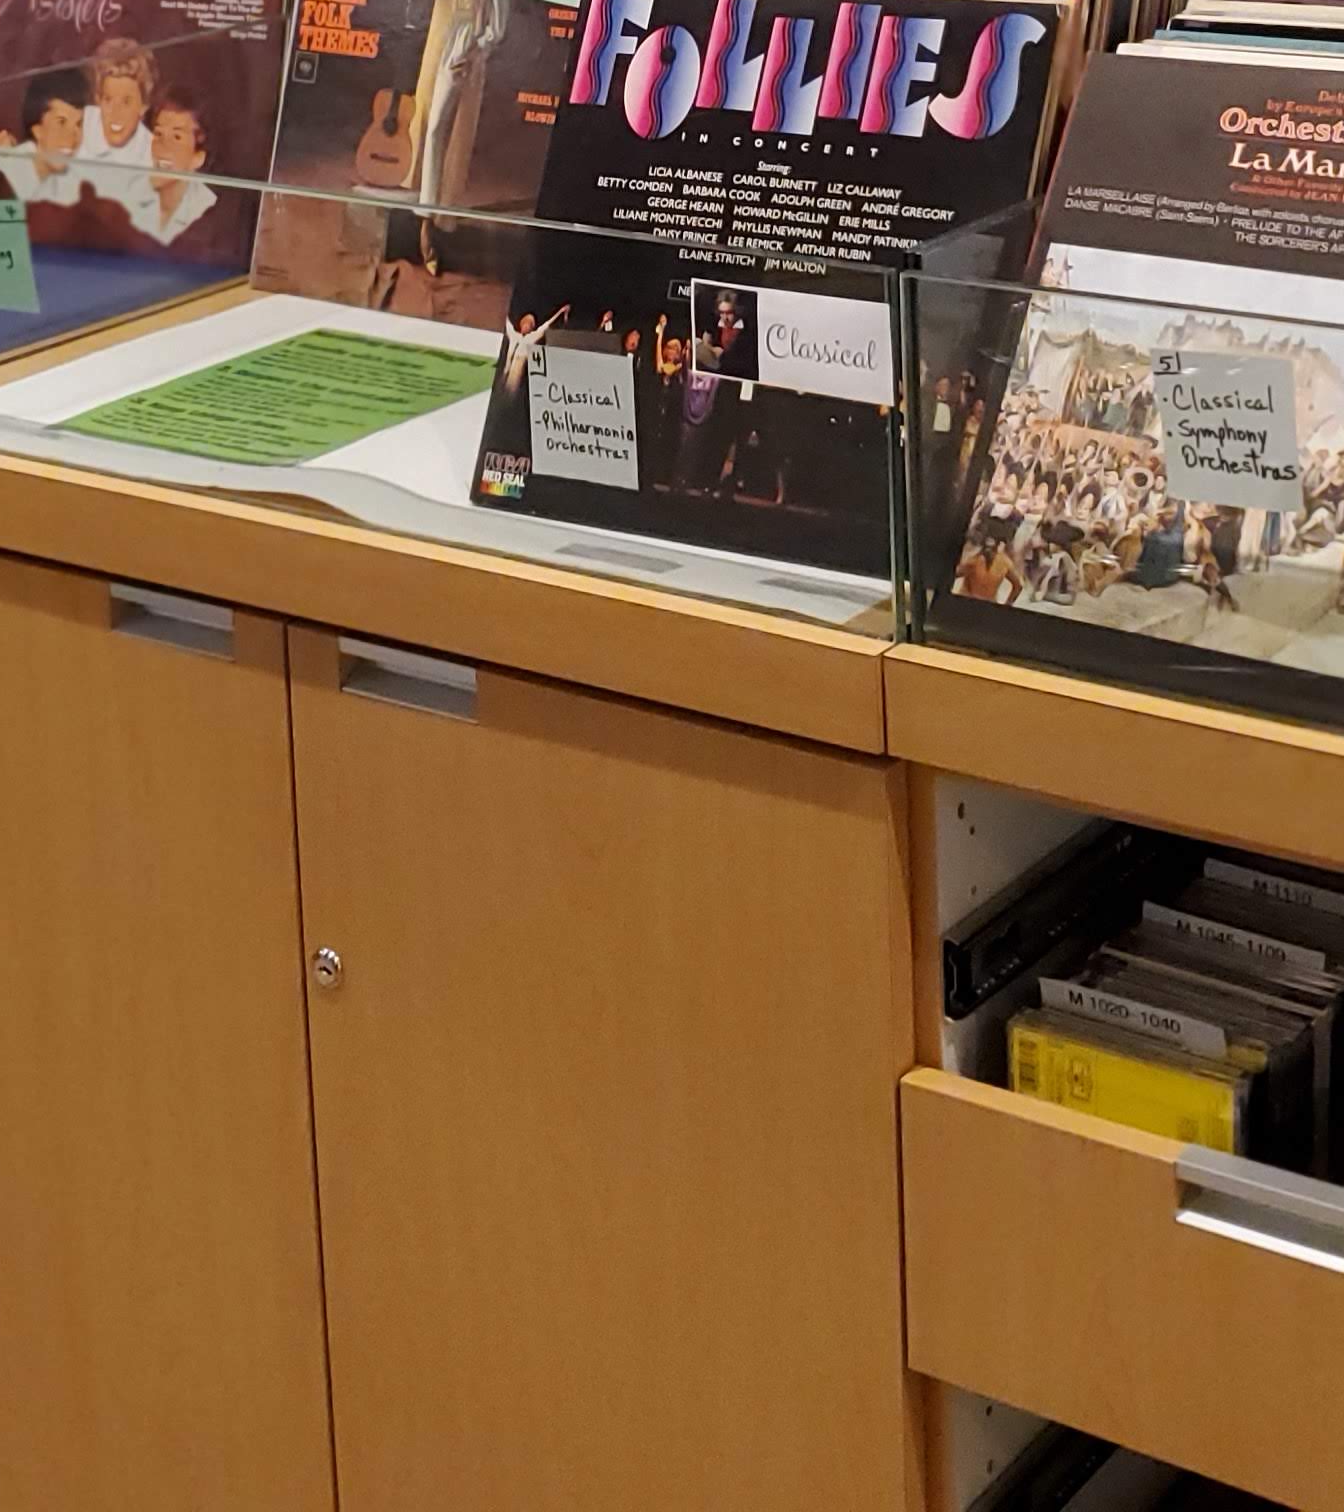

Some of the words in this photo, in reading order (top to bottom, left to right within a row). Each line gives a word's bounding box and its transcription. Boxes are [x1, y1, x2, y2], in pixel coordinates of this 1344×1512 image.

[301, 0, 355, 29] FOLK
[298, 25, 380, 59] THEMES
[1266, 99, 1282, 112] by
[681, 131, 708, 144] IN
[733, 137, 879, 157] CONCERT
[1228, 142, 1271, 171] La
[648, 166, 672, 178] LICIA
[674, 169, 723, 183] ALBANESE
[733, 174, 767, 187] CAROL
[769, 177, 818, 191] BURNETT
[827, 182, 843, 195] LIZ
[845, 184, 902, 199] CALLAWAY
[1067, 186, 1081, 196] LA
[1084, 187, 1156, 205] MARSEILLAISE
[1304, 189, 1337, 203] JEAN
[597, 176, 627, 189] BETTY
[629, 179, 673, 193] COMDEN
[682, 184, 726, 198] BARBARA
[729, 189, 761, 201] COOK
[771, 193, 814, 207] ADOLPH
[817, 197, 851, 211] GREEN
[861, 201, 899, 216] ANDRÉ
[901, 205, 955, 221] GREGORY
[613, 208, 648, 221] LILIANE
[650, 212, 723, 229] MONTEVECCHI
[732, 221, 771, 235] PHYLLIS
[772, 225, 822, 240] NEWMAN
[832, 231, 871, 246] MANDY
[647, 196, 687, 210] GEORGE
[689, 201, 724, 214] HEARN
[733, 205, 781, 219] HOWARD
[782, 210, 829, 225] McGILLIN
[839, 216, 860, 228] ERIE
[862, 218, 890, 231] MILLS
[1064, 198, 1100, 212] DANSE
[1102, 203, 1153, 218] MACABRE
[1231, 217, 1283, 232] PRELUDE
[1286, 224, 1301, 235] TO
[1304, 226, 1327, 239] THE
[682, 231, 718, 245] PRINCE
[728, 236, 745, 247] LEE
[746, 238, 784, 251] REMICK
[794, 243, 835, 257] ARTHUR
[838, 249, 871, 261] RUBIN
[1234, 231, 1256, 244] THE
[679, 248, 712, 262] ELAINE
[715, 252, 756, 266] STRITCH
[764, 258, 780, 271] JIM
[782, 260, 826, 275] WALTON
[533, 351, 542, 367] 4
[765, 322, 878, 371] Classical
[548, 382, 621, 410] Classical
[1172, 384, 1274, 414] Classical
[547, 437, 629, 460] Orchestras
[1178, 419, 1267, 454] Symphony
[482, 469, 502, 482] RED
[503, 472, 525, 487] SEAL
[1181, 447, 1297, 481] Orchestras
[1176, 919, 1191, 934] M
[1068, 990, 1084, 1007] M
